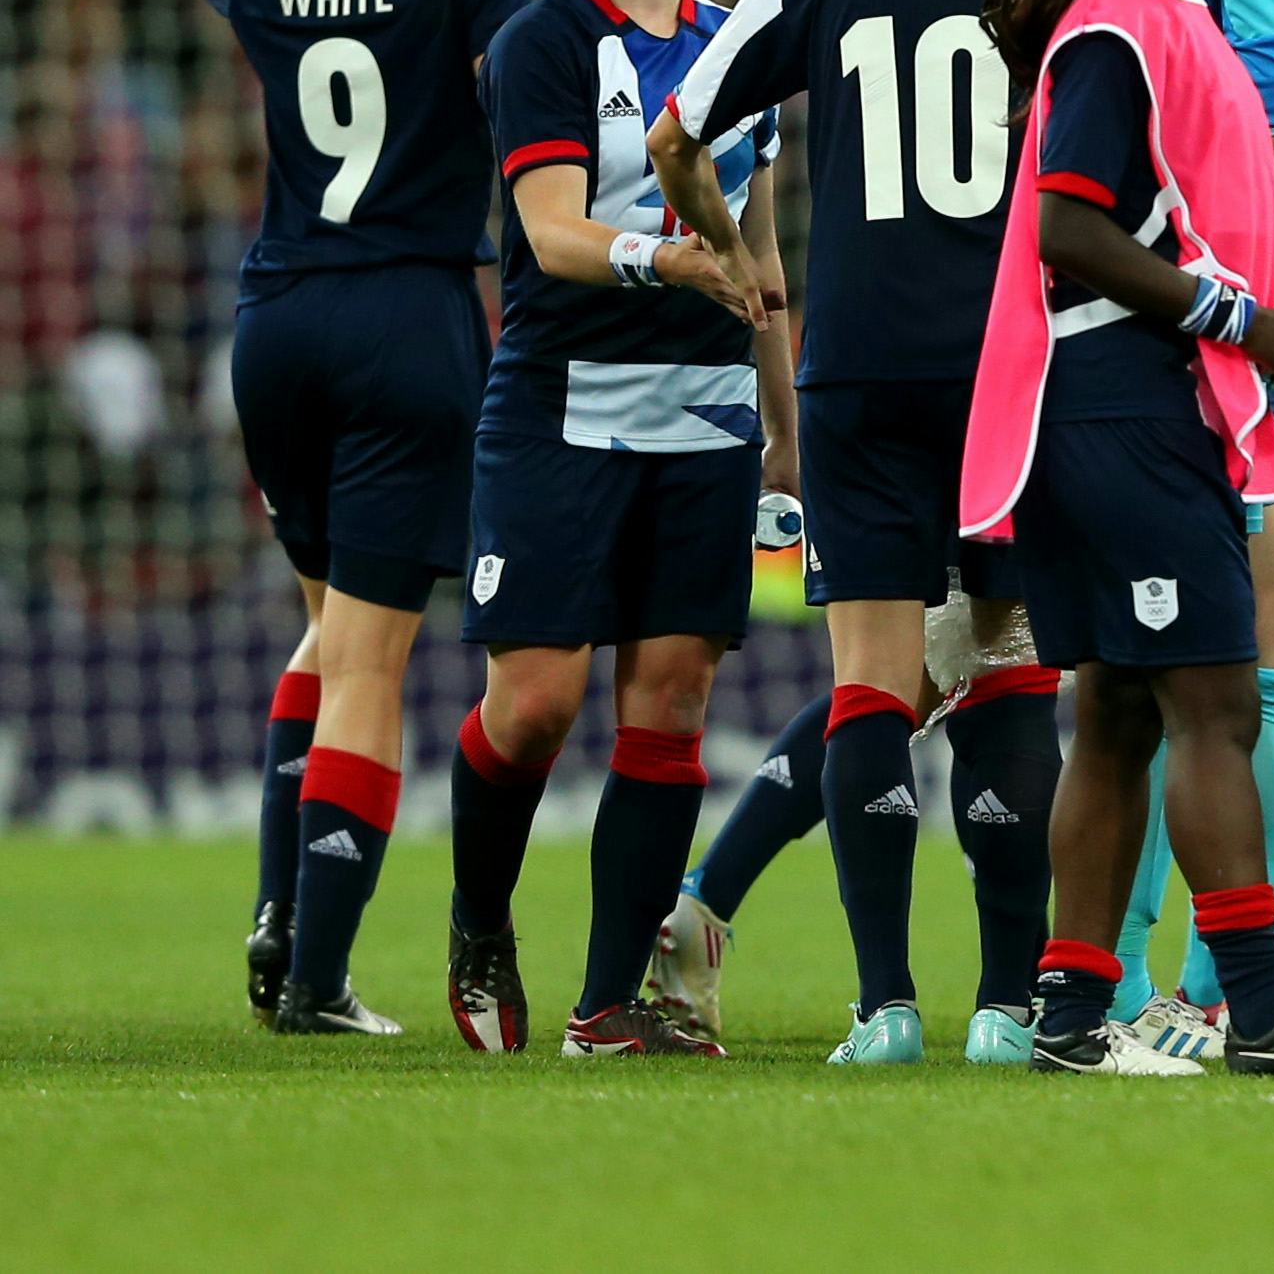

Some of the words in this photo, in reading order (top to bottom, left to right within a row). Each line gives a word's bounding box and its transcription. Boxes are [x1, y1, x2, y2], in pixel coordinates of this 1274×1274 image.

[297, 37, 387, 224] 9
[599, 107, 641, 118] adidas
[839, 14, 1010, 221] 10
